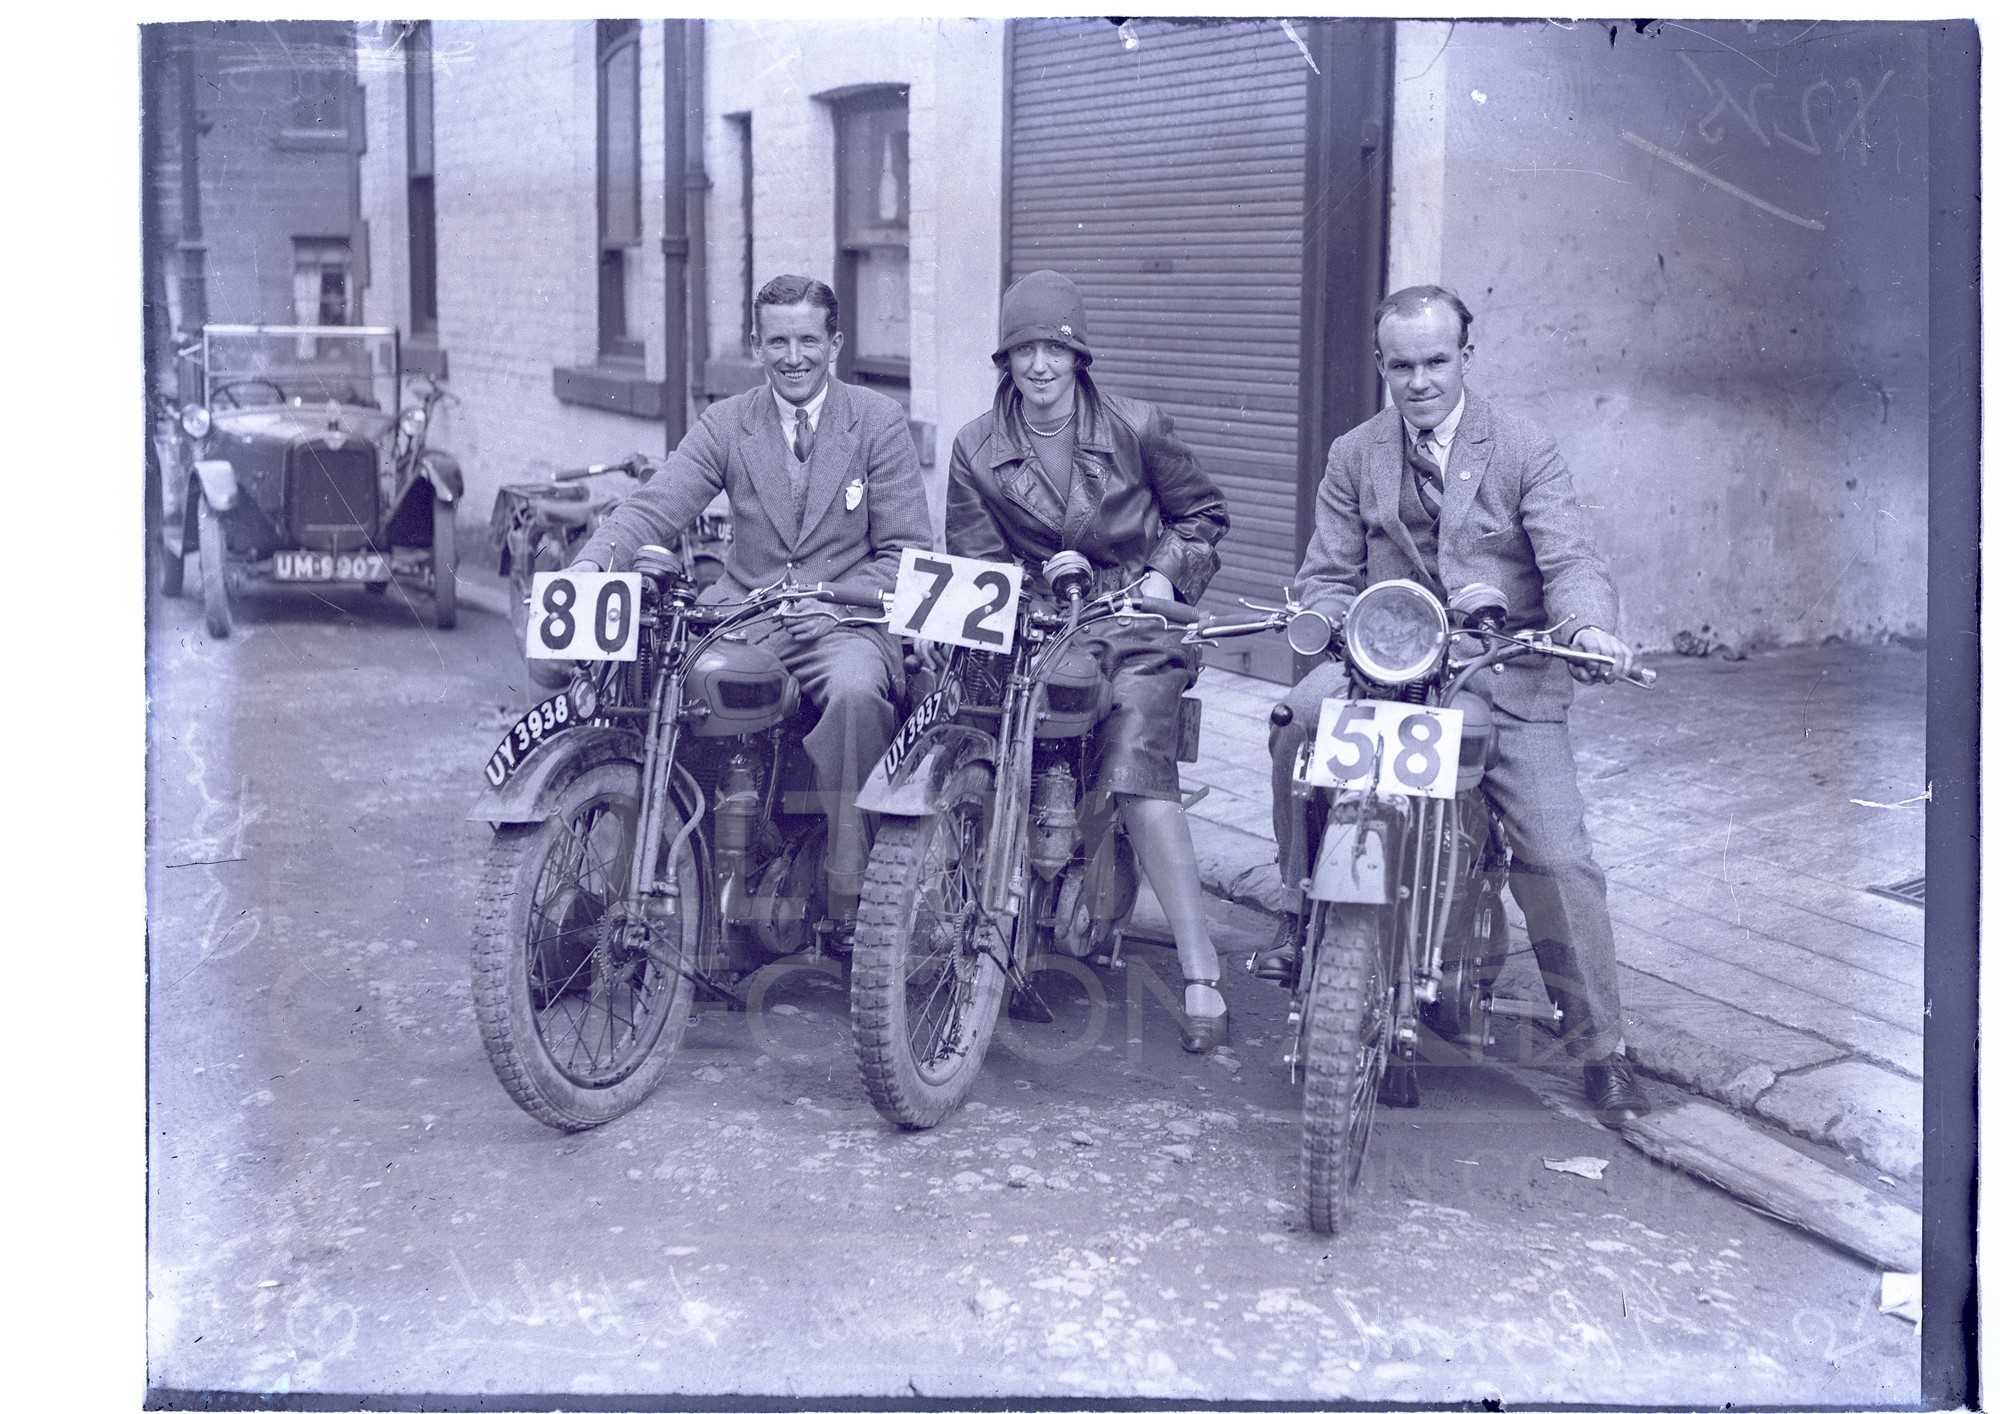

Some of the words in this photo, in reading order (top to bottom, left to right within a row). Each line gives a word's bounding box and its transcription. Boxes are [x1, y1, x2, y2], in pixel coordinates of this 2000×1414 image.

[540, 578, 631, 654] 80
[905, 557, 1011, 646] 72
[486, 735, 515, 786] UY
[514, 694, 569, 751] 3938
[886, 727, 906, 775] UY
[907, 692, 942, 744] 3937
[1326, 705, 1443, 788] 58
